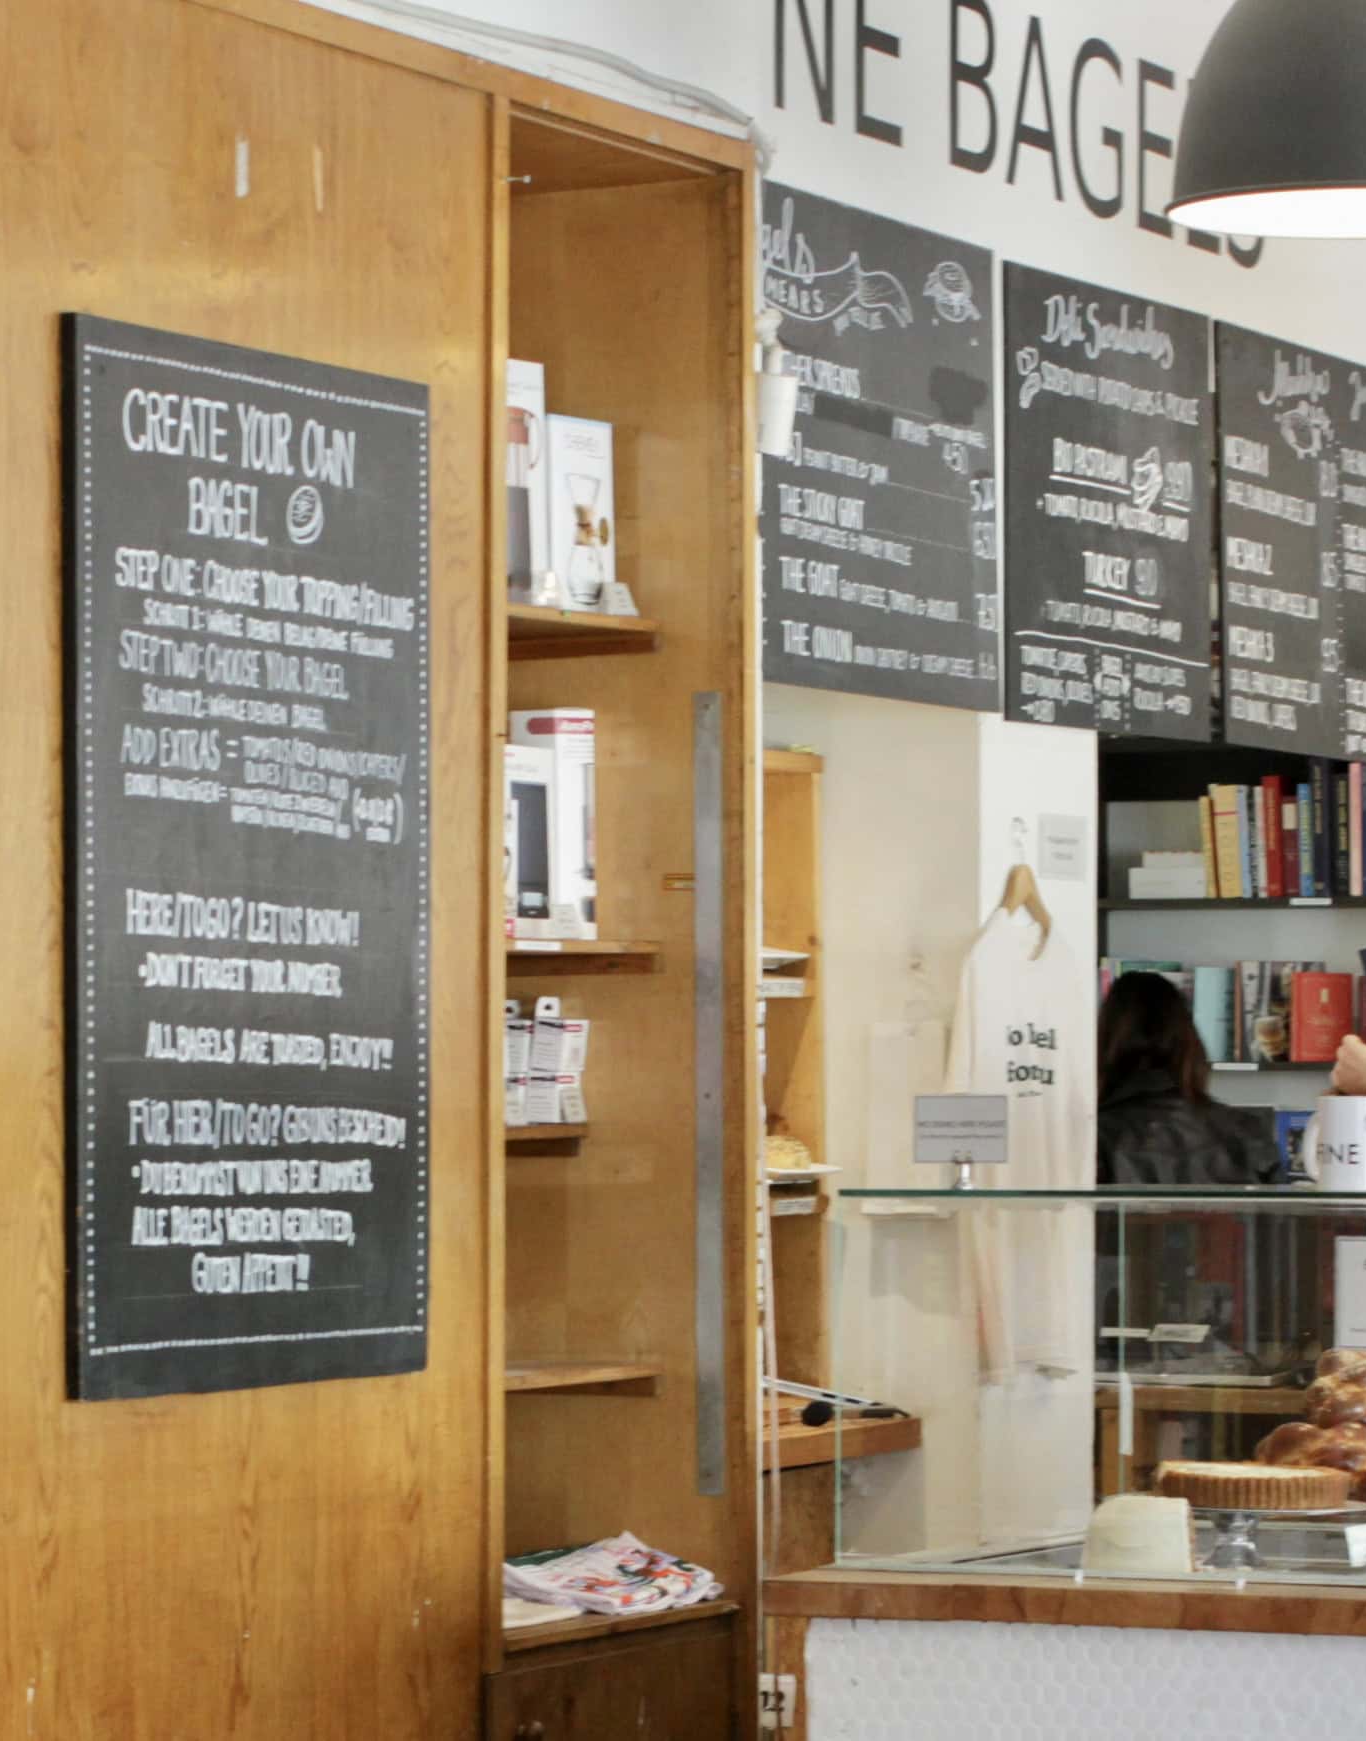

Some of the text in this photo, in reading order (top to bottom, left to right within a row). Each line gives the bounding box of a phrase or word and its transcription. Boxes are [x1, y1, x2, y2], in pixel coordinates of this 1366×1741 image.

[949, 0, 1264, 269] BAGE
[122, 388, 356, 488] CREATE YOUR OWN
[188, 477, 269, 546] BAGEL
[115, 547, 160, 592] STEP
[202, 560, 261, 606] CHOOSE
[262, 570, 299, 612] YOUR
[119, 629, 161, 674] STEP
[204, 643, 261, 688] CHOOSE
[262, 651, 302, 692] YOUR
[303, 657, 350, 700] BAGEL
[121, 723, 221, 771] ADD EXTRAS
[306, 907, 360, 947] KNOW!
[145, 1021, 174, 1059] ALL
[175, 1025, 236, 1064] BAGELS
